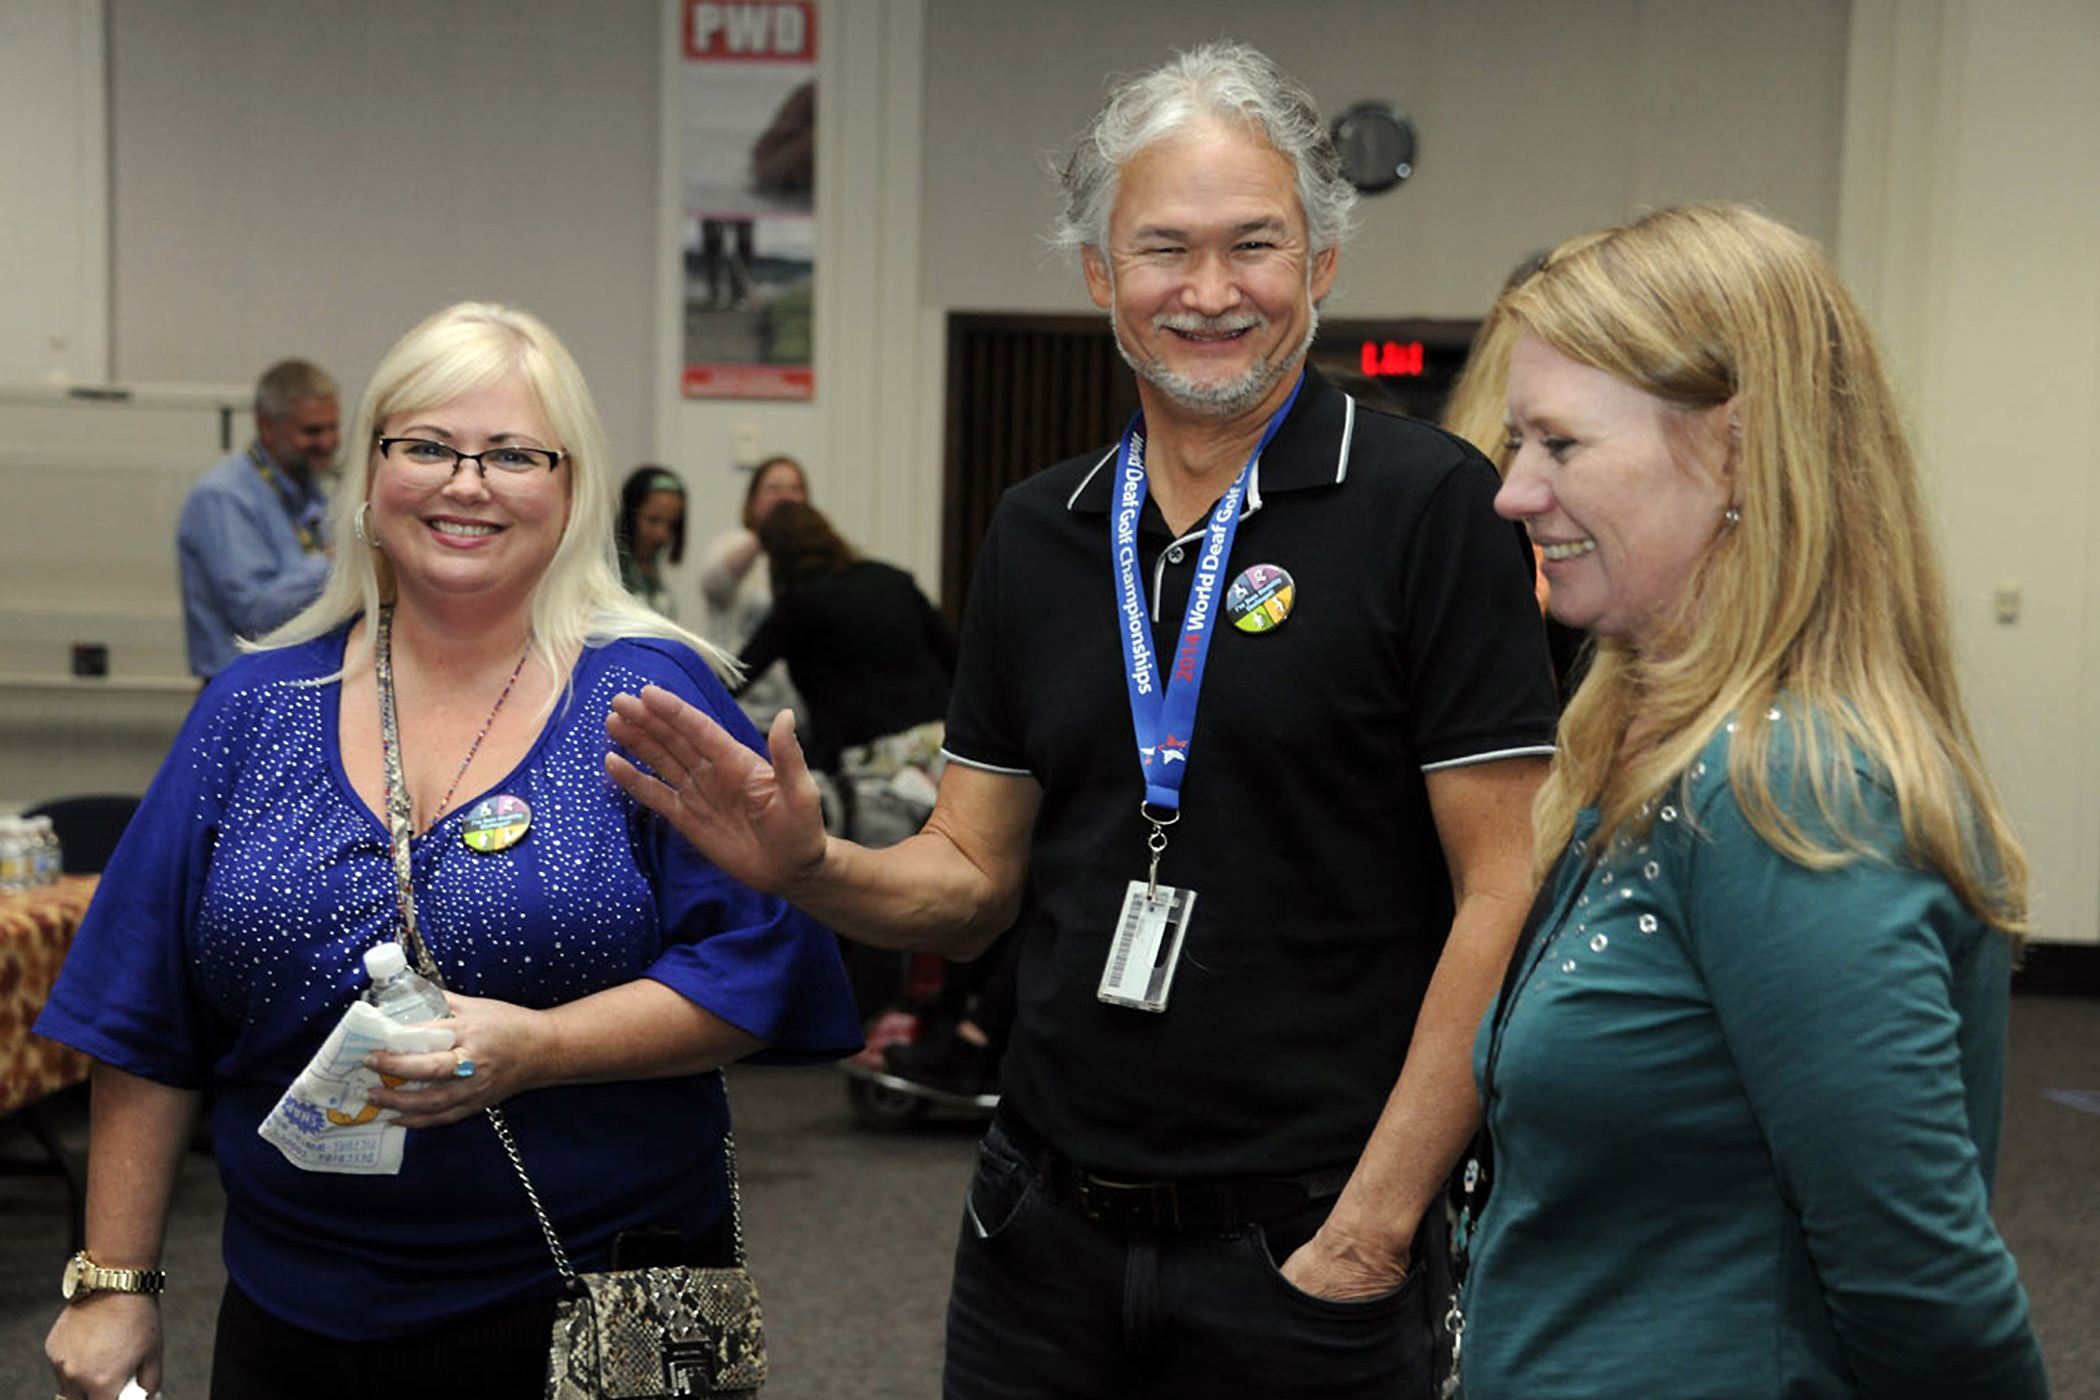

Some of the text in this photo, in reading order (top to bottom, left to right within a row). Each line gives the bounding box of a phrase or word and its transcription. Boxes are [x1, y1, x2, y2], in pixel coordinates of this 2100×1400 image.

[695, 2, 806, 53] PWD
[1122, 468, 1144, 507] Deaf
[1216, 487, 1240, 522] Golf
[1118, 509, 1136, 544] Golf
[1202, 524, 1226, 570] Deaf
[1119, 546, 1152, 695] Championships
[1187, 573, 1215, 631] World
[1175, 633, 1200, 682] 2014
